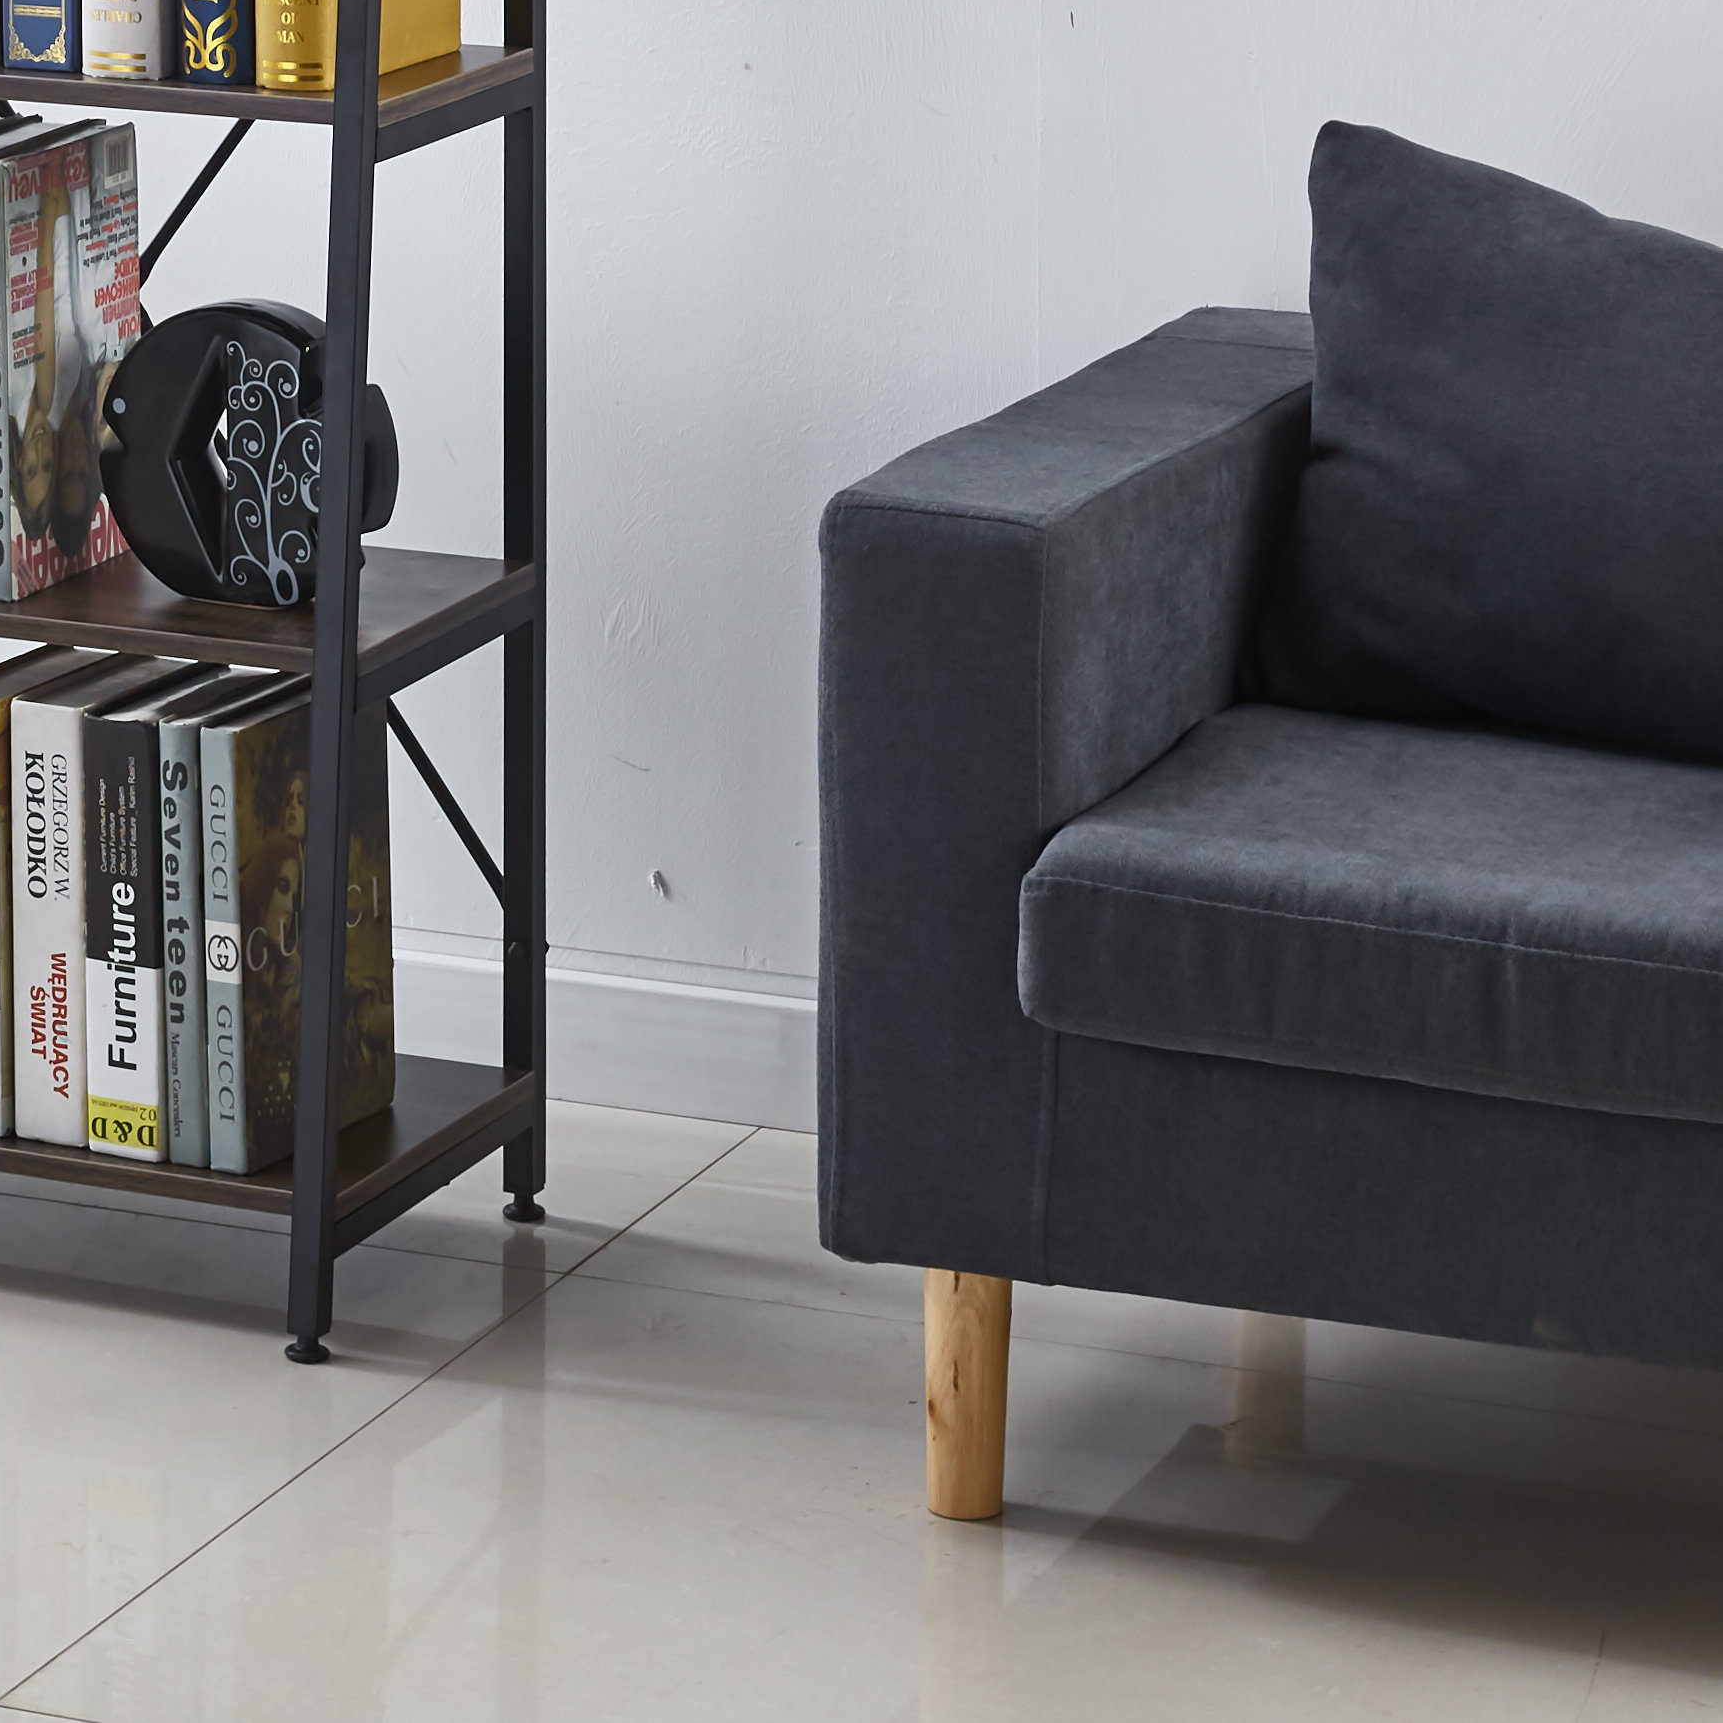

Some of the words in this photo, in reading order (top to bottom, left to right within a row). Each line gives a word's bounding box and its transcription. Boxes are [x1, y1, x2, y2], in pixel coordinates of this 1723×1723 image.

[25, 750, 47, 898] KOŁODKO
[51, 754, 70, 873] GRZEGORZ
[162, 760, 188, 902] Seven
[209, 784, 228, 903] GUCCI
[107, 882, 137, 1070] Furniture
[167, 916, 190, 1024] teen
[246, 876, 378, 971] GUCI
[30, 986, 50, 1059] ŚWIAT
[48, 953, 69, 1099] WĘDRUJĄCY
[216, 1005, 236, 1123] GUCCI
[140, 1107, 157, 1121] 02
